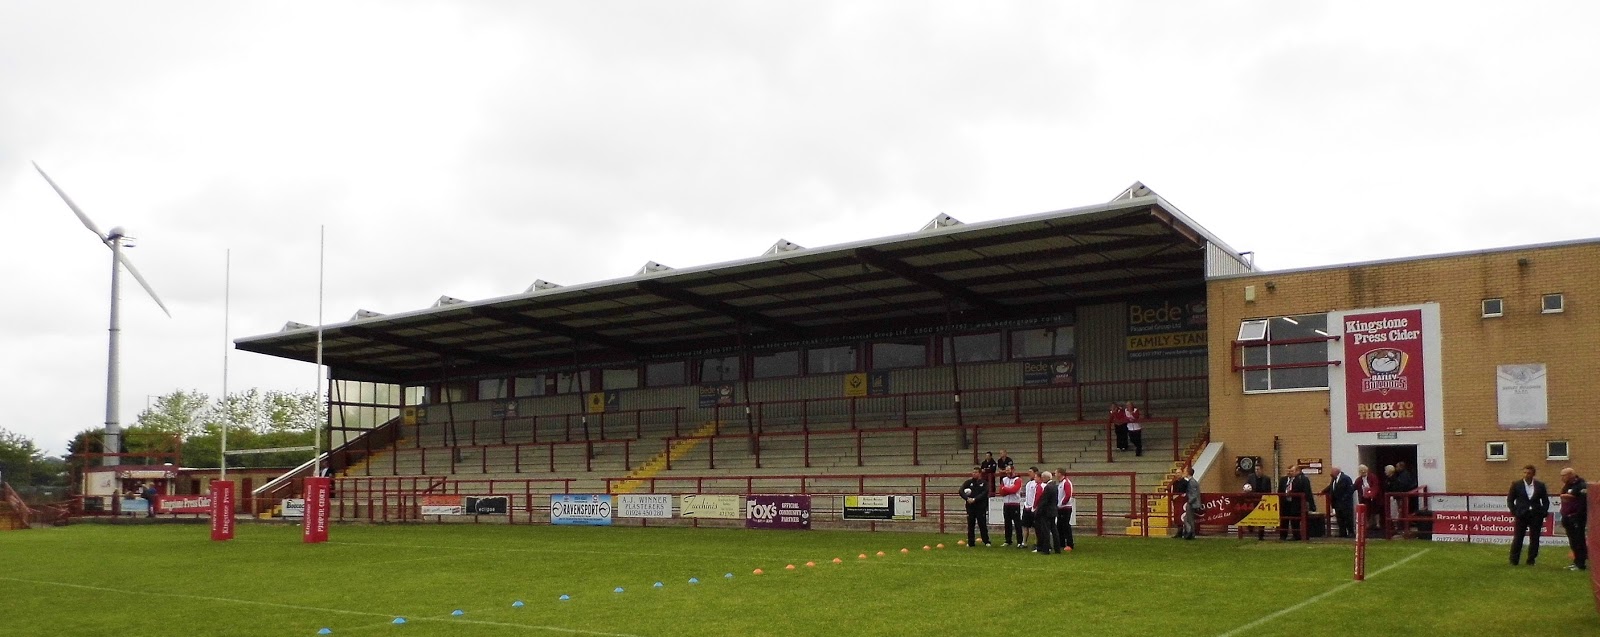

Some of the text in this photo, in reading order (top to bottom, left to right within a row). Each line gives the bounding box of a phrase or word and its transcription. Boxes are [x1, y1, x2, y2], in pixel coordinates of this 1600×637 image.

[1129, 300, 1182, 324] Bede
[1346, 317, 1408, 333] Kingstone
[1130, 332, 1206, 348] FAMILY STAN
[1354, 329, 1420, 345] Press Cider
[1024, 361, 1048, 372] Bede
[1357, 401, 1413, 411] RUGBY TO
[1358, 410, 1413, 420] THE CORE
[286, 500, 305, 509] Boococ
[639, 496, 668, 504] WINNER
[563, 503, 599, 516] RAVENSPORT
[1258, 502, 1278, 511] 411
[1482, 514, 1517, 524] develop
